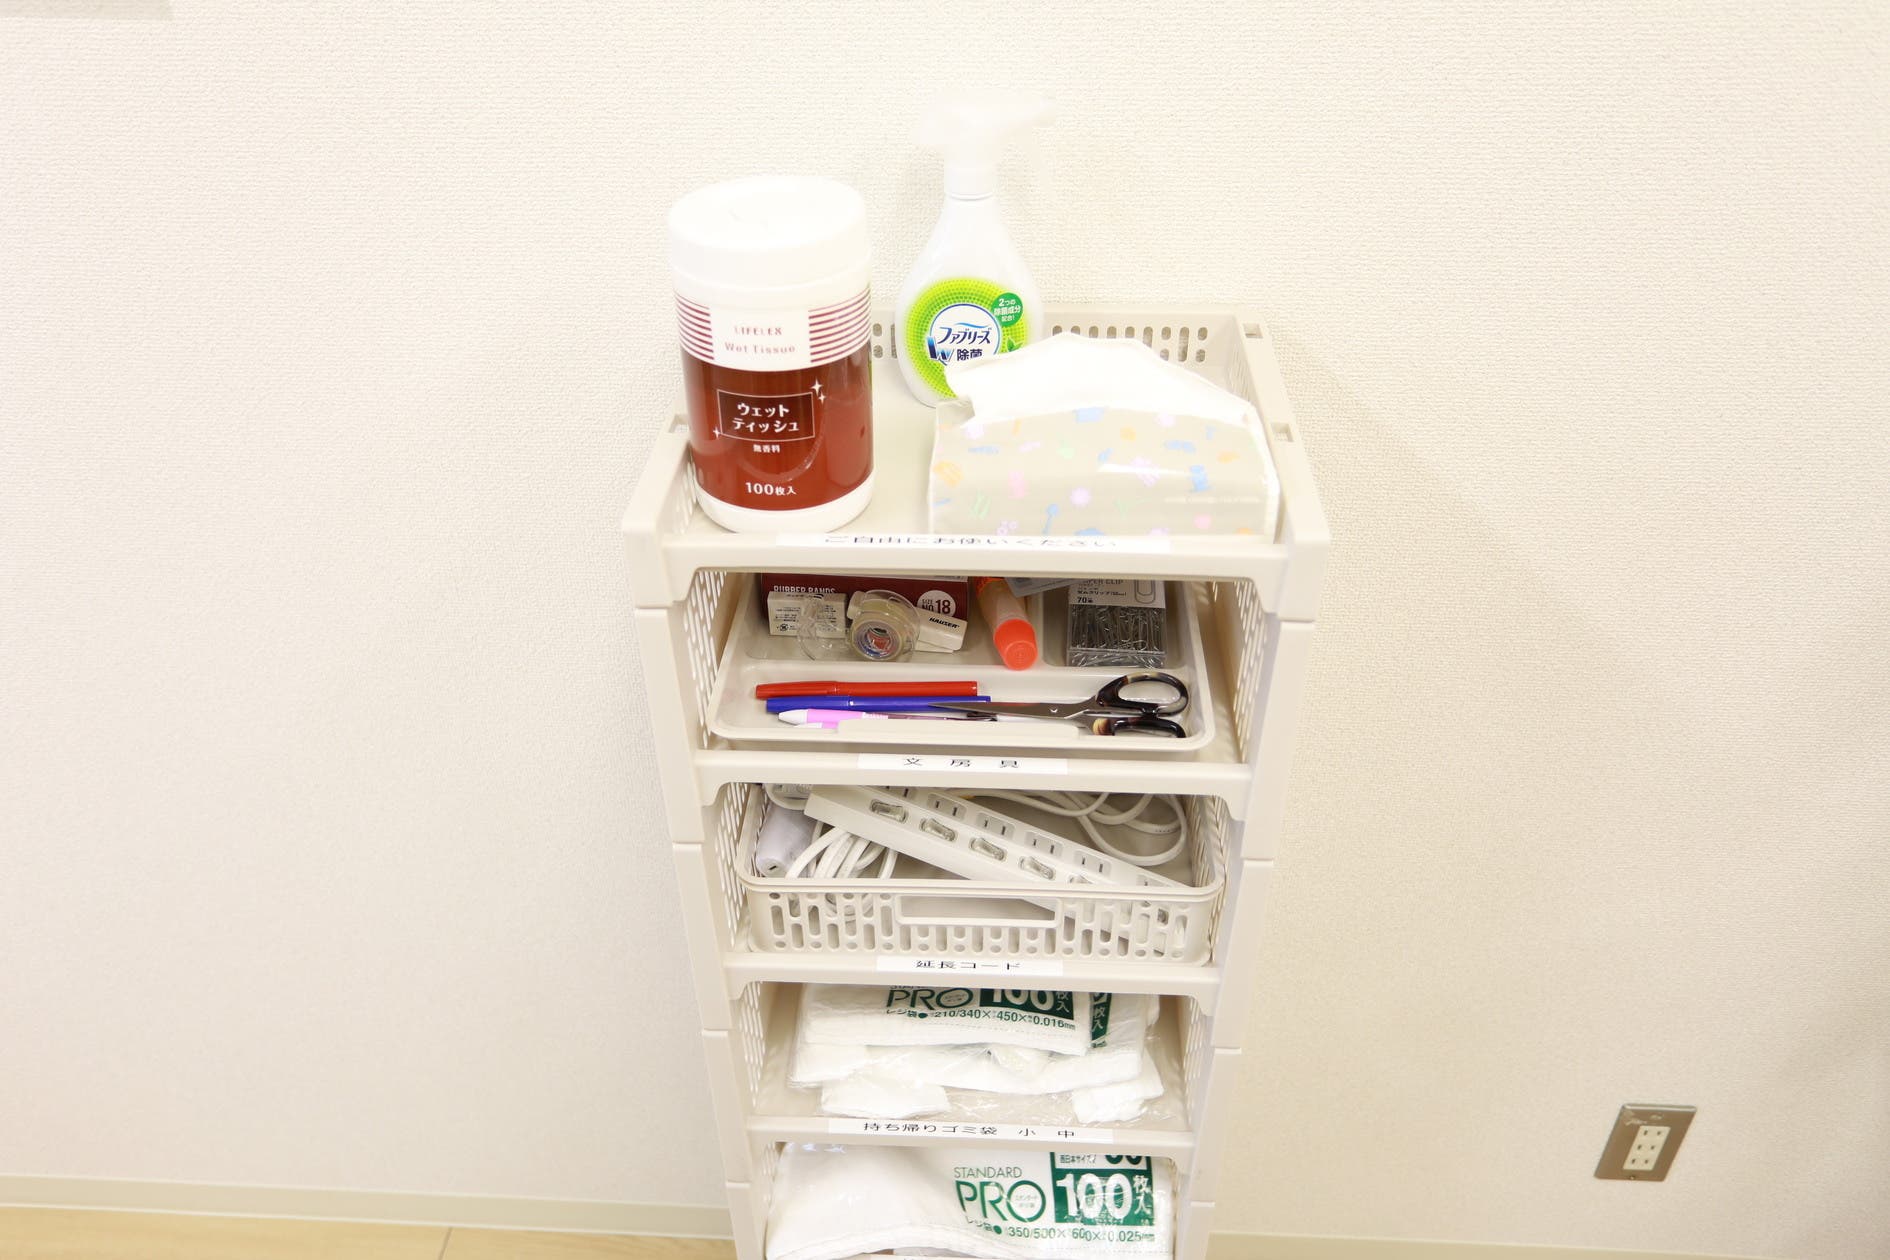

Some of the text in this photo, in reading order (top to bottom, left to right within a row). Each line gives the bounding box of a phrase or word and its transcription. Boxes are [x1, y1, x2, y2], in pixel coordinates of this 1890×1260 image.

[998, 298, 1016, 307] 2つの
[937, 326, 993, 345] ファブリーズ
[724, 341, 797, 354] Wet Tissue
[737, 402, 790, 418] ウェット
[732, 417, 799, 433] ティッシュ
[753, 444, 780, 453] 無香料
[745, 482, 797, 496] 100枚入
[935, 599, 951, 615] 18
[928, 617, 958, 629] HAUSER
[915, 960, 1021, 970] 延長コード
[886, 987, 974, 1010] PRO
[863, 1122, 1075, 1138] 持ち帰りゴミ袋 小 中
[954, 1166, 1023, 1179] STANDARD
[955, 1180, 1047, 1223] PRO
[1056, 1172, 1132, 1219] 100
